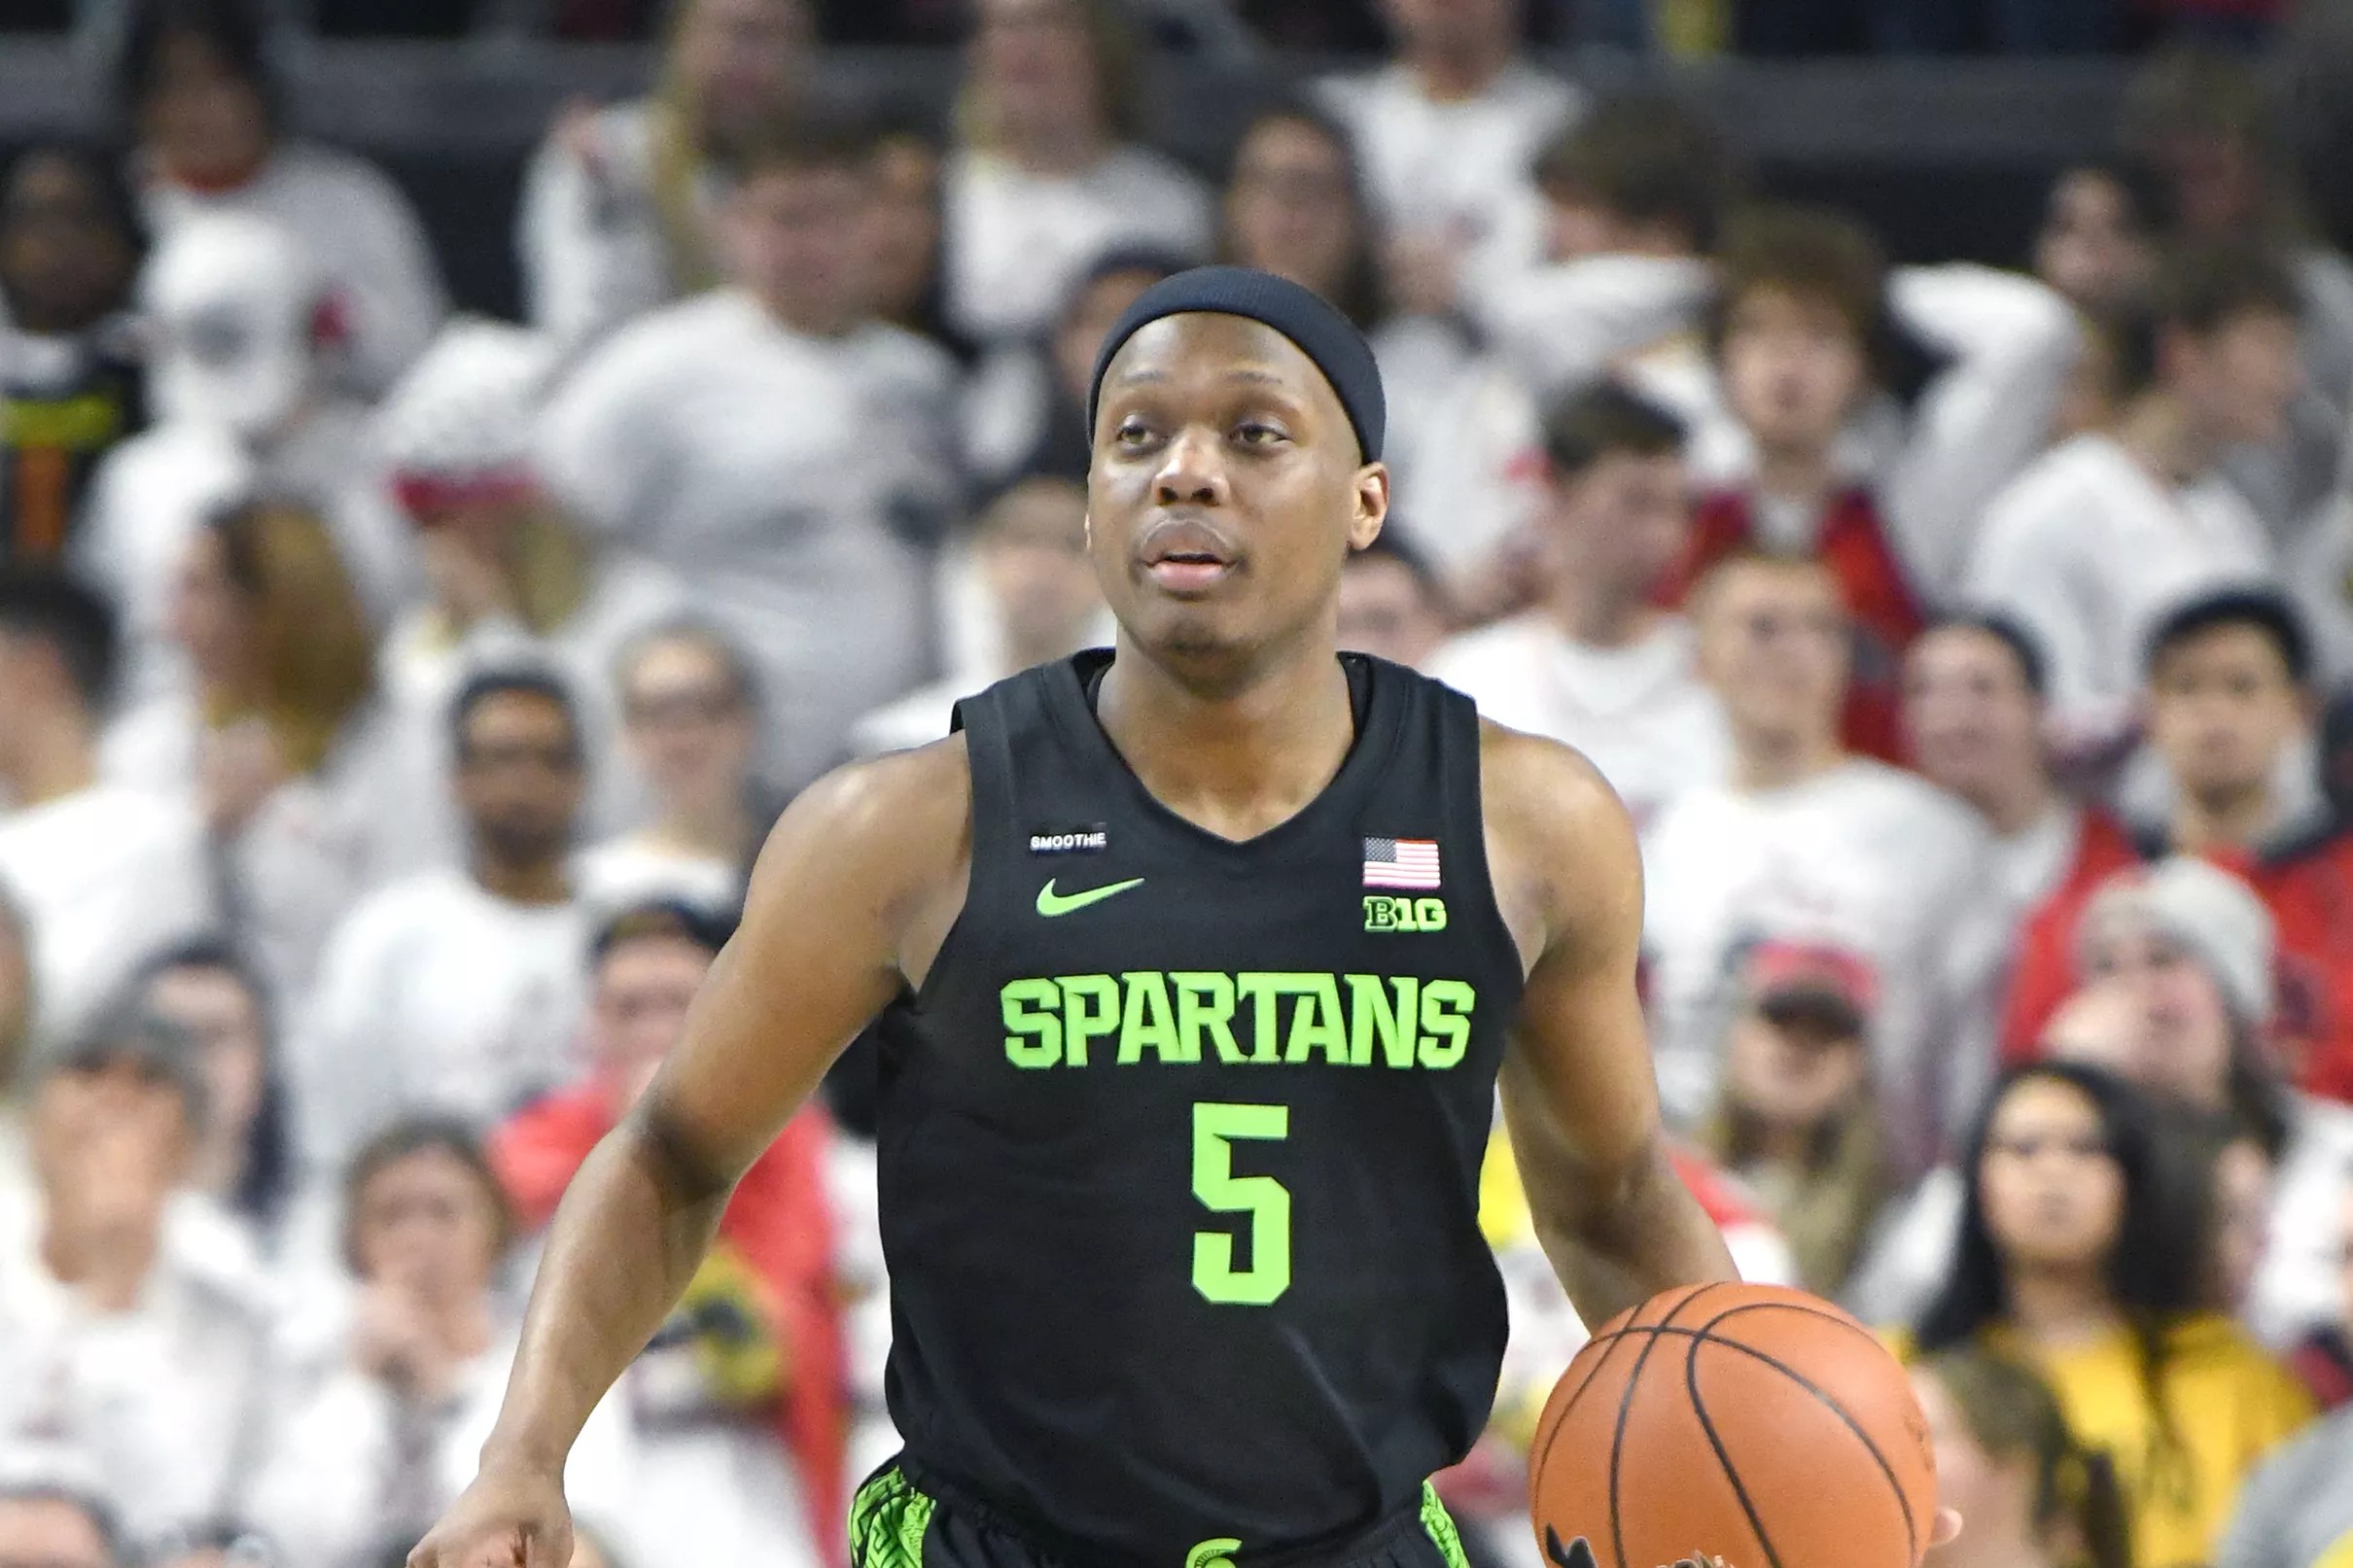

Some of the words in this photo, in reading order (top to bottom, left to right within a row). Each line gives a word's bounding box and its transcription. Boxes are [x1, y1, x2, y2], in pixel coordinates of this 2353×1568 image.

[1031, 832, 1106, 851] SMOOTHIE
[1000, 971, 1476, 1069] SPARTANS
[1191, 1101, 1291, 1306] 5
